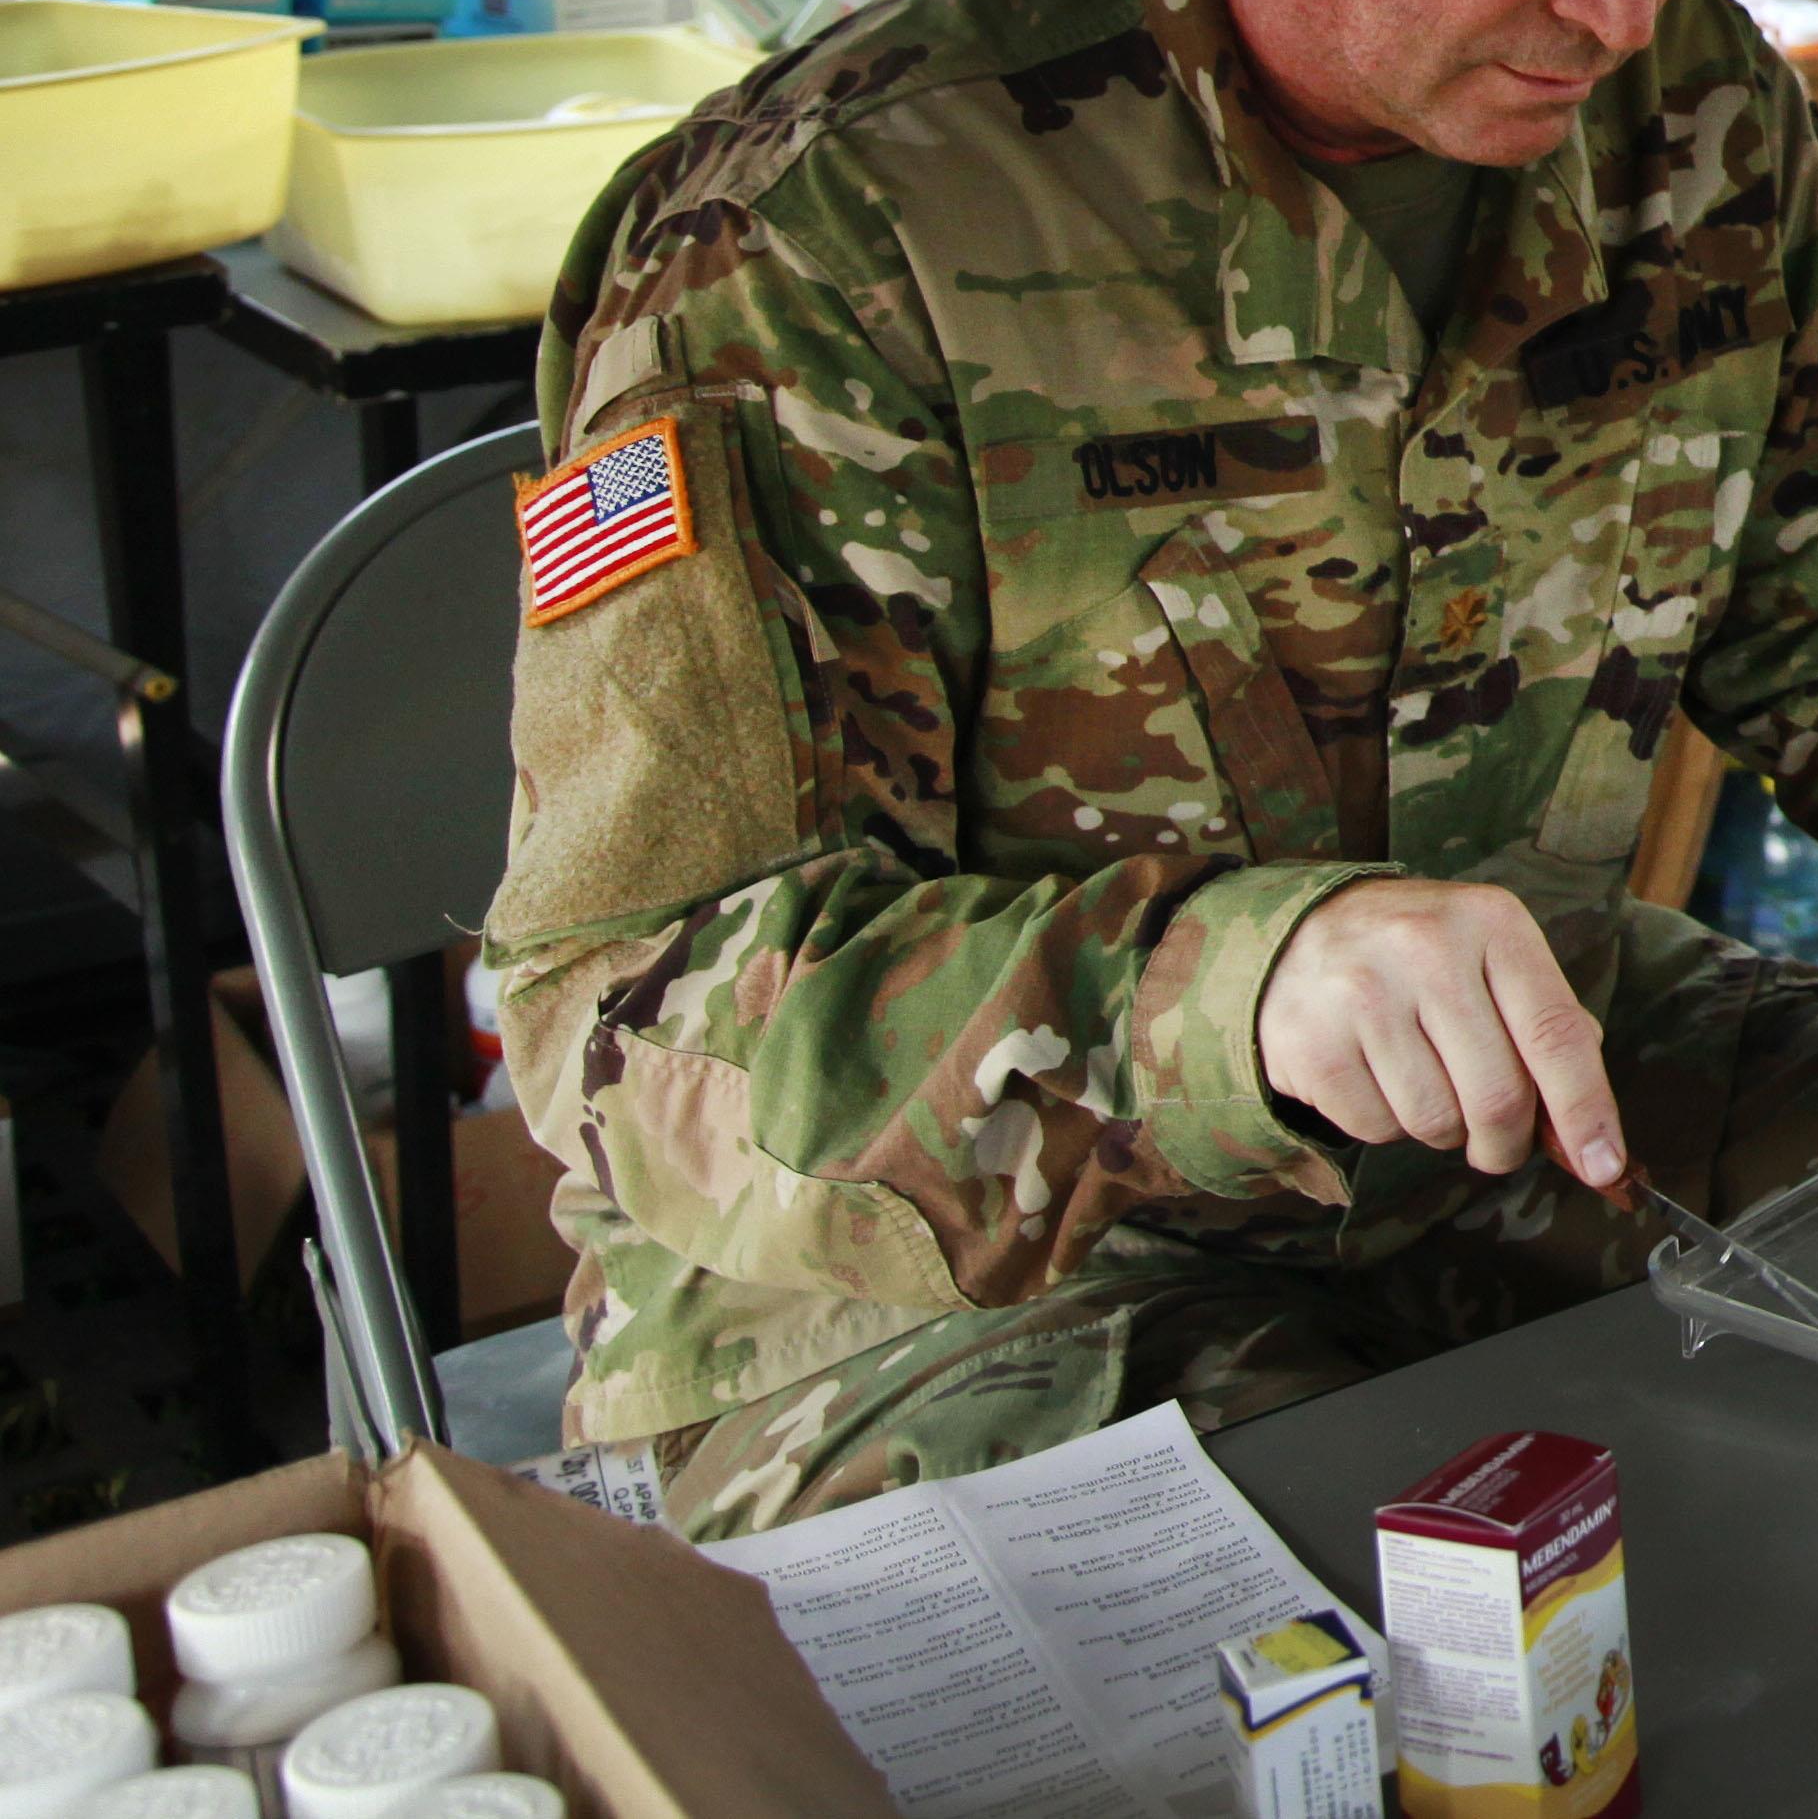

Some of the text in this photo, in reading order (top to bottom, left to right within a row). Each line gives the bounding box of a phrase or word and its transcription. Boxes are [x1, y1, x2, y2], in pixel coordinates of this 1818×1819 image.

[1079, 432, 1217, 500] OLSON
[634, 1482, 657, 1520] APAP
[1522, 1498, 1614, 1577] MEBENDAMIN
